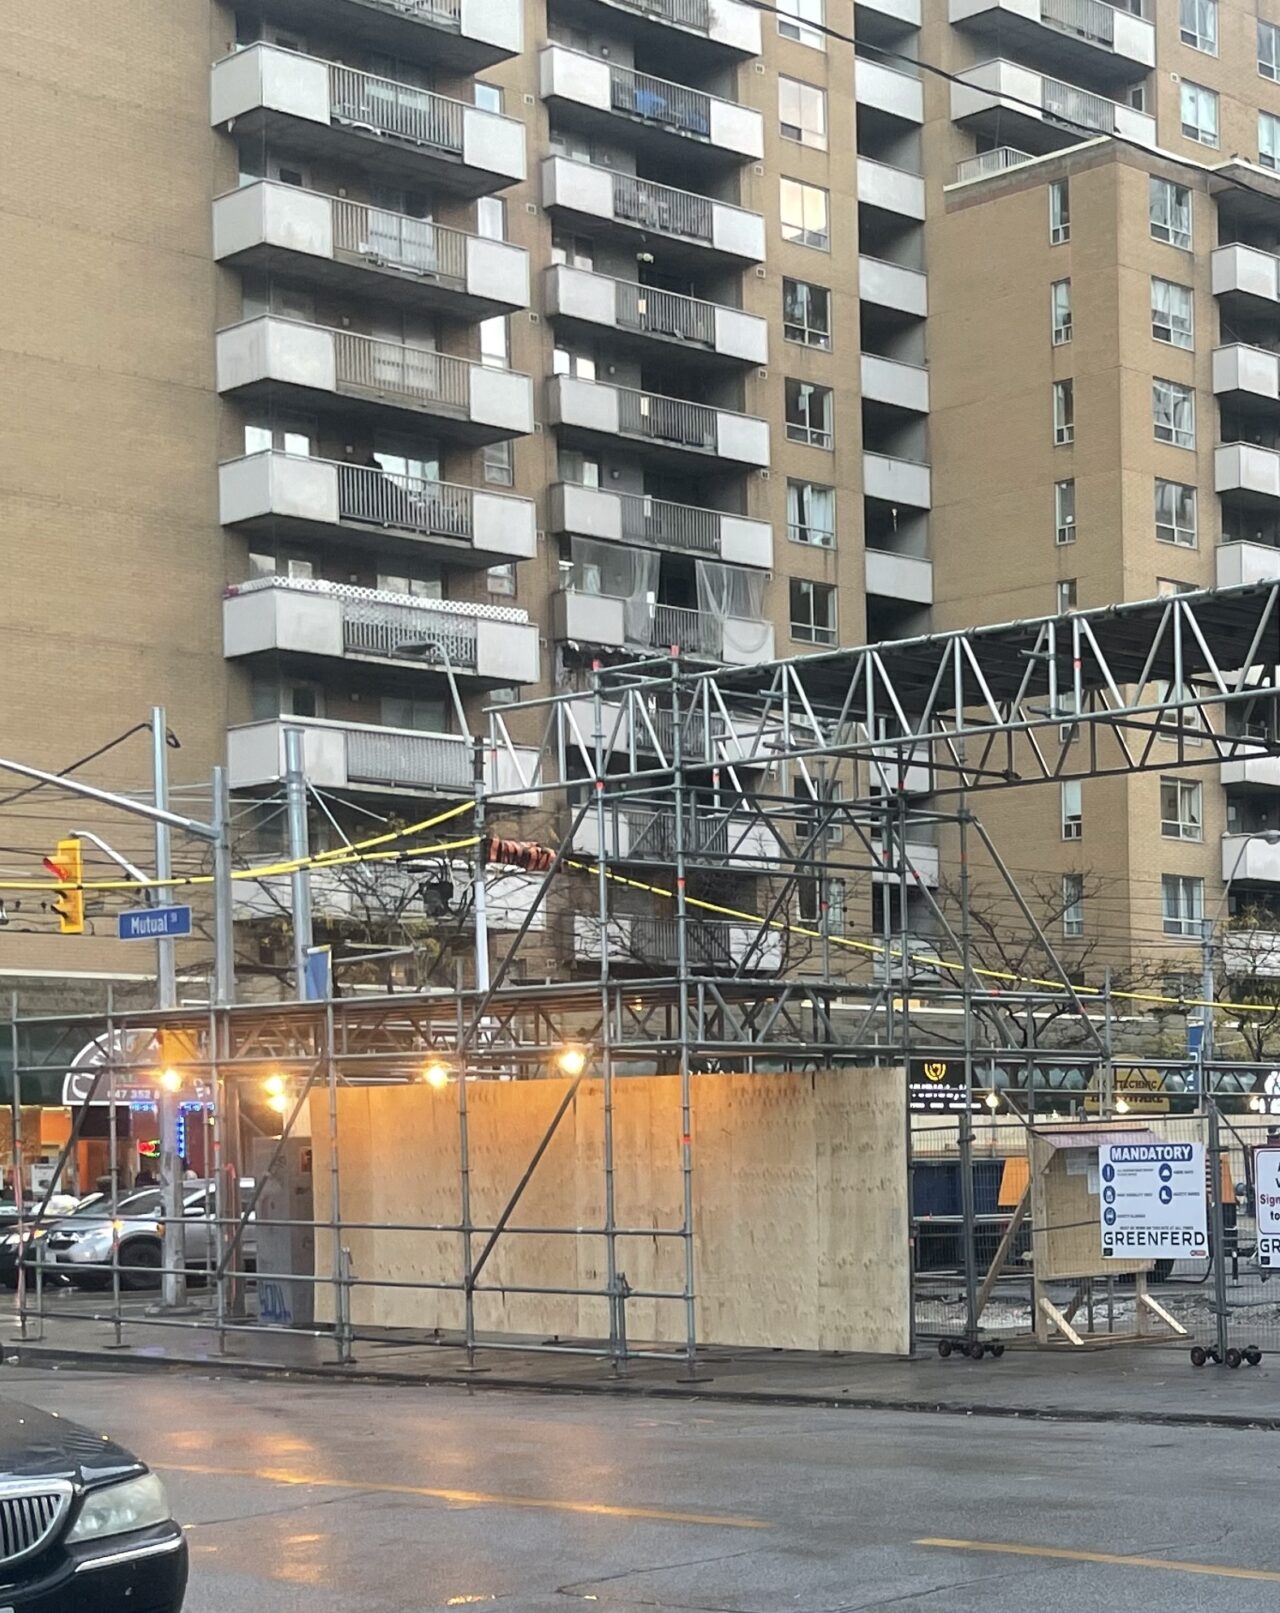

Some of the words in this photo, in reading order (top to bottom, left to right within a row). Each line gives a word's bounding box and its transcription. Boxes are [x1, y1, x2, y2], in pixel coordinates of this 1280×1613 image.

[131, 912, 168, 935] Mutual
[1097, 1079, 1157, 1089] POYTECHNIC
[1111, 1146, 1191, 1161] MANDATORY
[1270, 1211, 1280, 1221] to
[1103, 1231, 1205, 1246] GREENFERD
